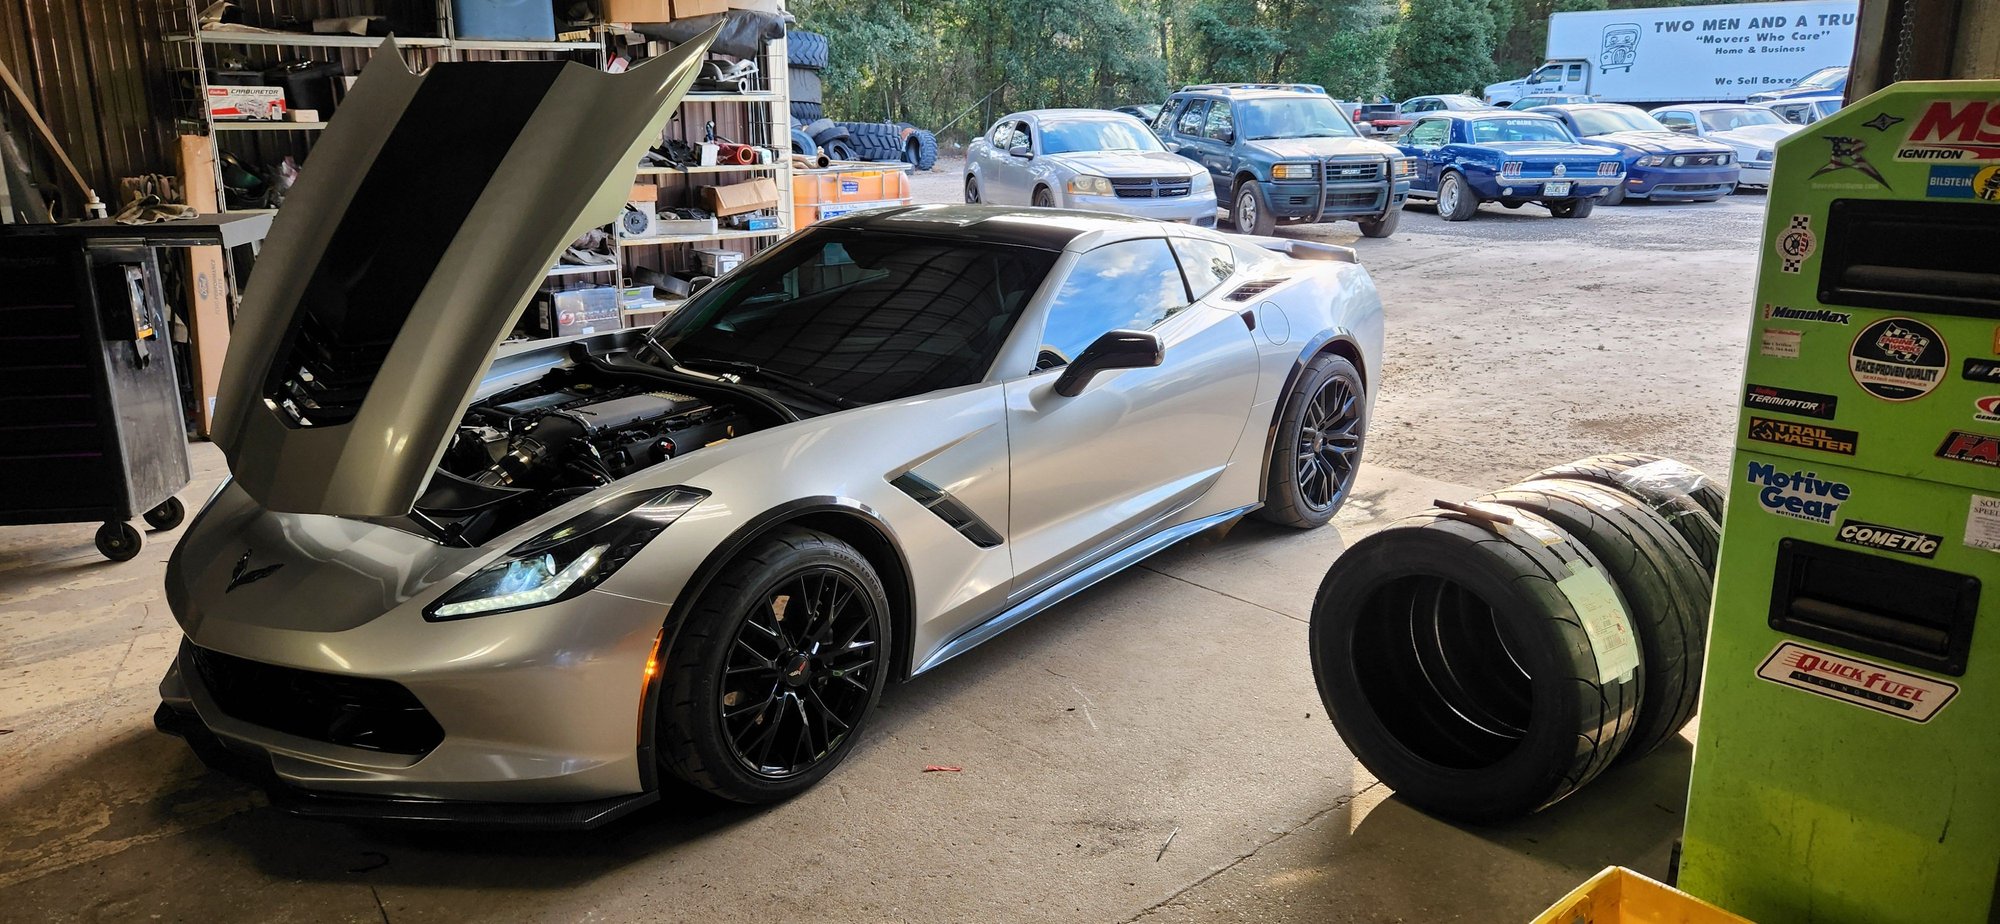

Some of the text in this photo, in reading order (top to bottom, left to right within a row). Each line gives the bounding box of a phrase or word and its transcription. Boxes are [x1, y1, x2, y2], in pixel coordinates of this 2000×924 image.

[1654, 20, 1695, 33] TWO
[1702, 18, 1741, 32] MEN
[1748, 16, 1787, 30] AND
[1795, 15, 1808, 27] A
[1756, 33, 1785, 43] Who
[1715, 45, 1806, 55] Home & Business
[1715, 77, 1733, 86] We
[1737, 77, 1758, 85] Sell
[1898, 149, 1964, 160] IGNITION
[1930, 177, 1973, 187] BILSTEIN
[199, 276, 208, 298] Ford
[1771, 306, 1850, 325] MonoMax
[1881, 335, 1914, 346] ENGINE
[1890, 343, 1921, 353] WORKS
[1905, 367, 1939, 383] QUALITY
[1749, 393, 1820, 411] TERMINATOR
[1775, 422, 1833, 440] TRAIL
[1775, 432, 1853, 453] MASTER
[1947, 436, 2000, 462] FA
[1974, 458, 1998, 467] SPARK
[1748, 461, 1850, 501] Motive
[1760, 486, 1840, 520] Gear
[1980, 500, 2000, 508] SOU
[1776, 509, 1831, 525] MOTIVEGEAR.COM
[1841, 525, 1938, 554] COMETIC
[1796, 653, 1926, 702] QUICK FUEL
[1796, 673, 1911, 709] TECHNOLOGY
